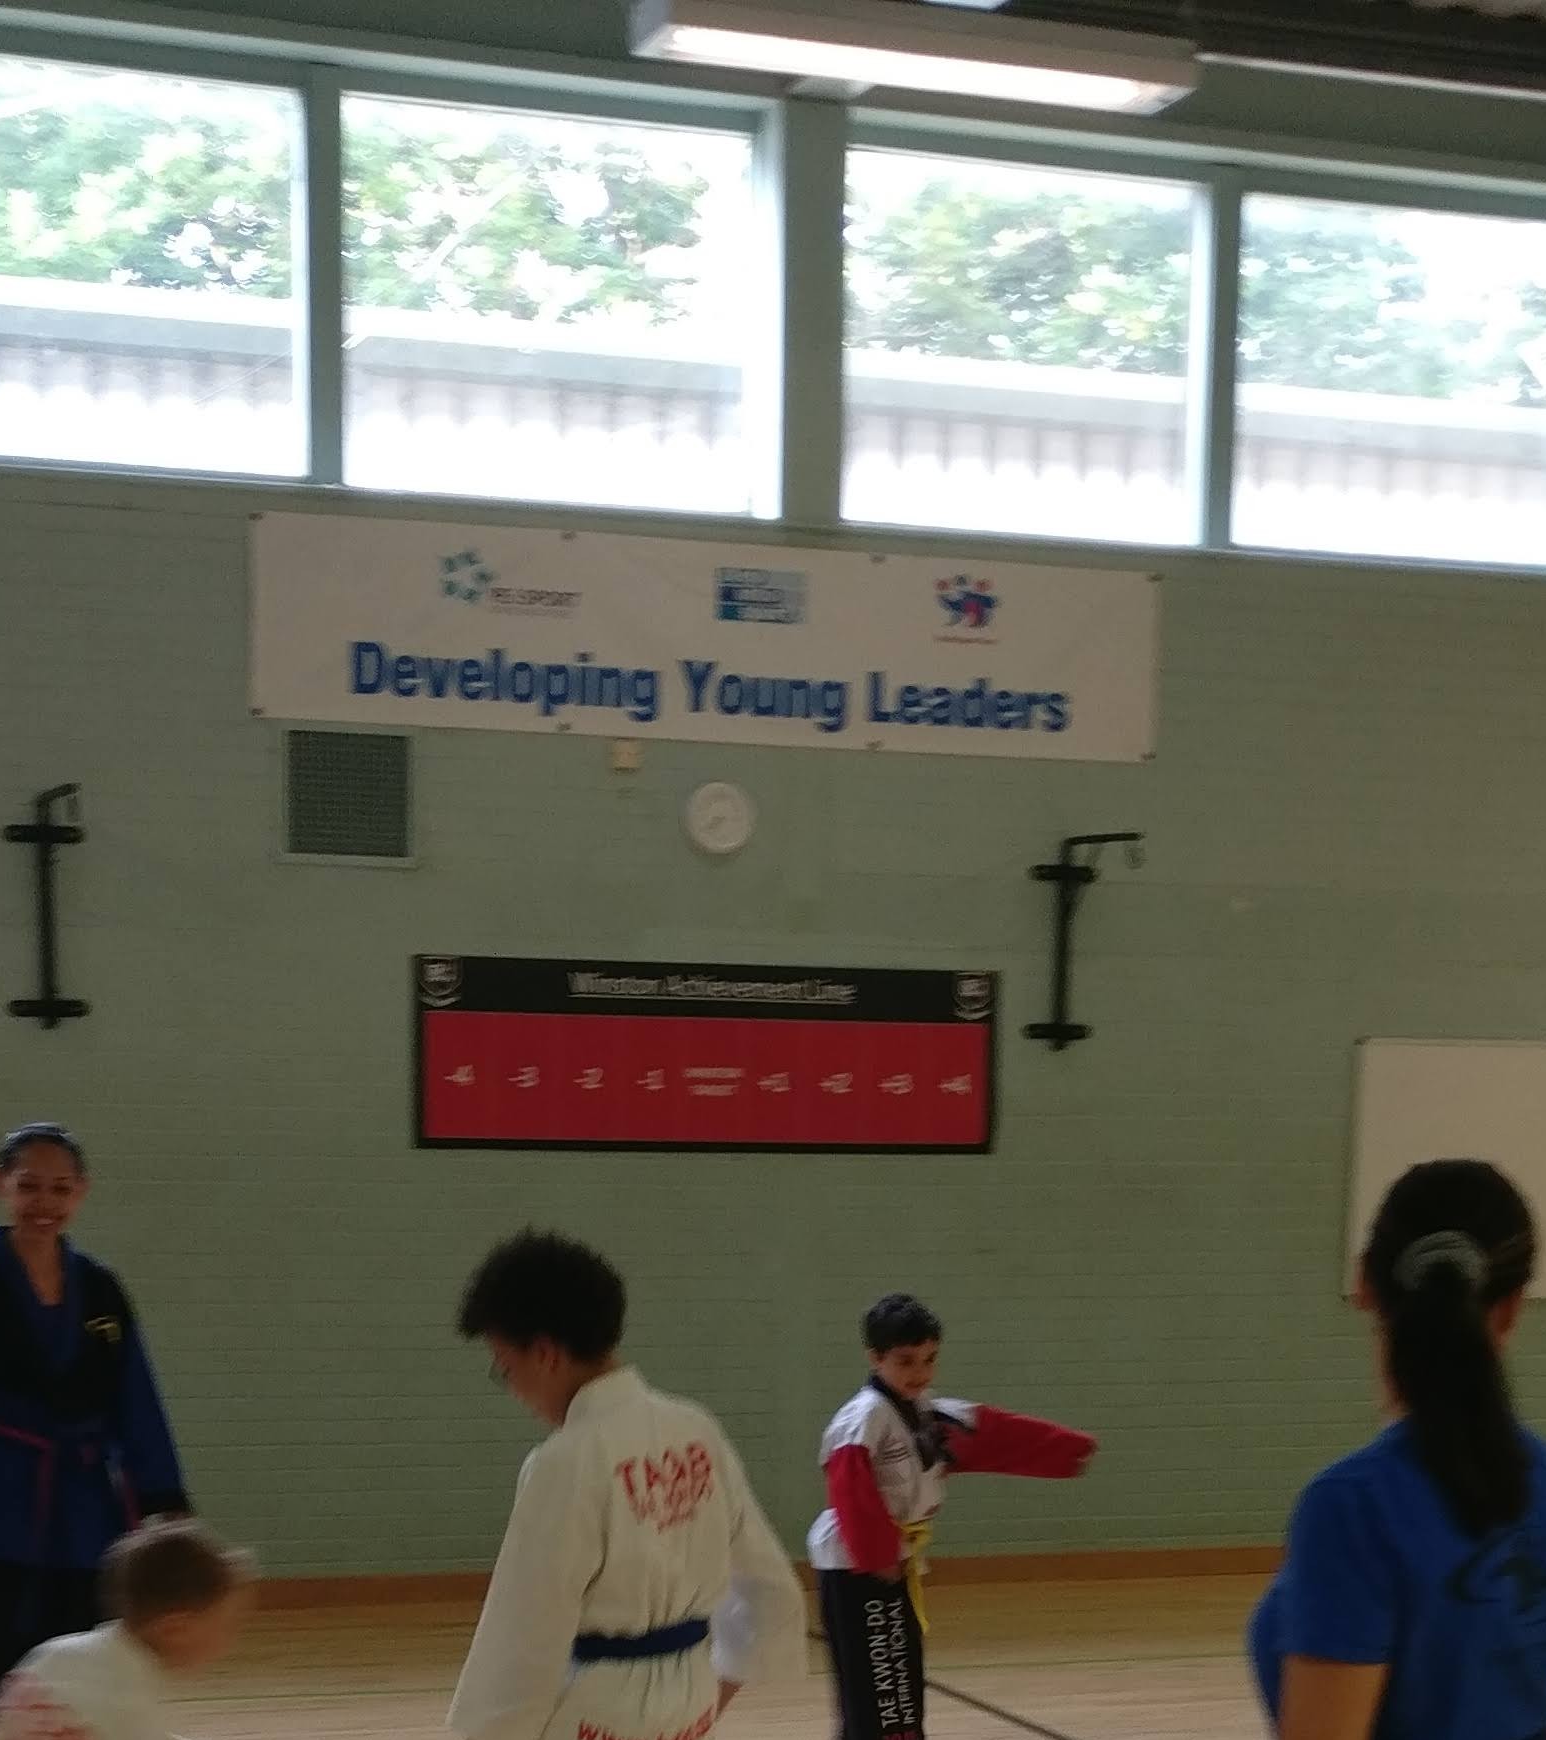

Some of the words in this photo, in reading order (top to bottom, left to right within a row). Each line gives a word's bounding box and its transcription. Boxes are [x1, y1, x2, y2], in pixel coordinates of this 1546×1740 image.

[349, 641, 661, 722] Developing
[677, 660, 851, 733] Young
[865, 671, 1071, 732] Leaders
[887, 1598, 917, 1725] INTERNATIONAL
[877, 1696, 900, 1729] TAE
